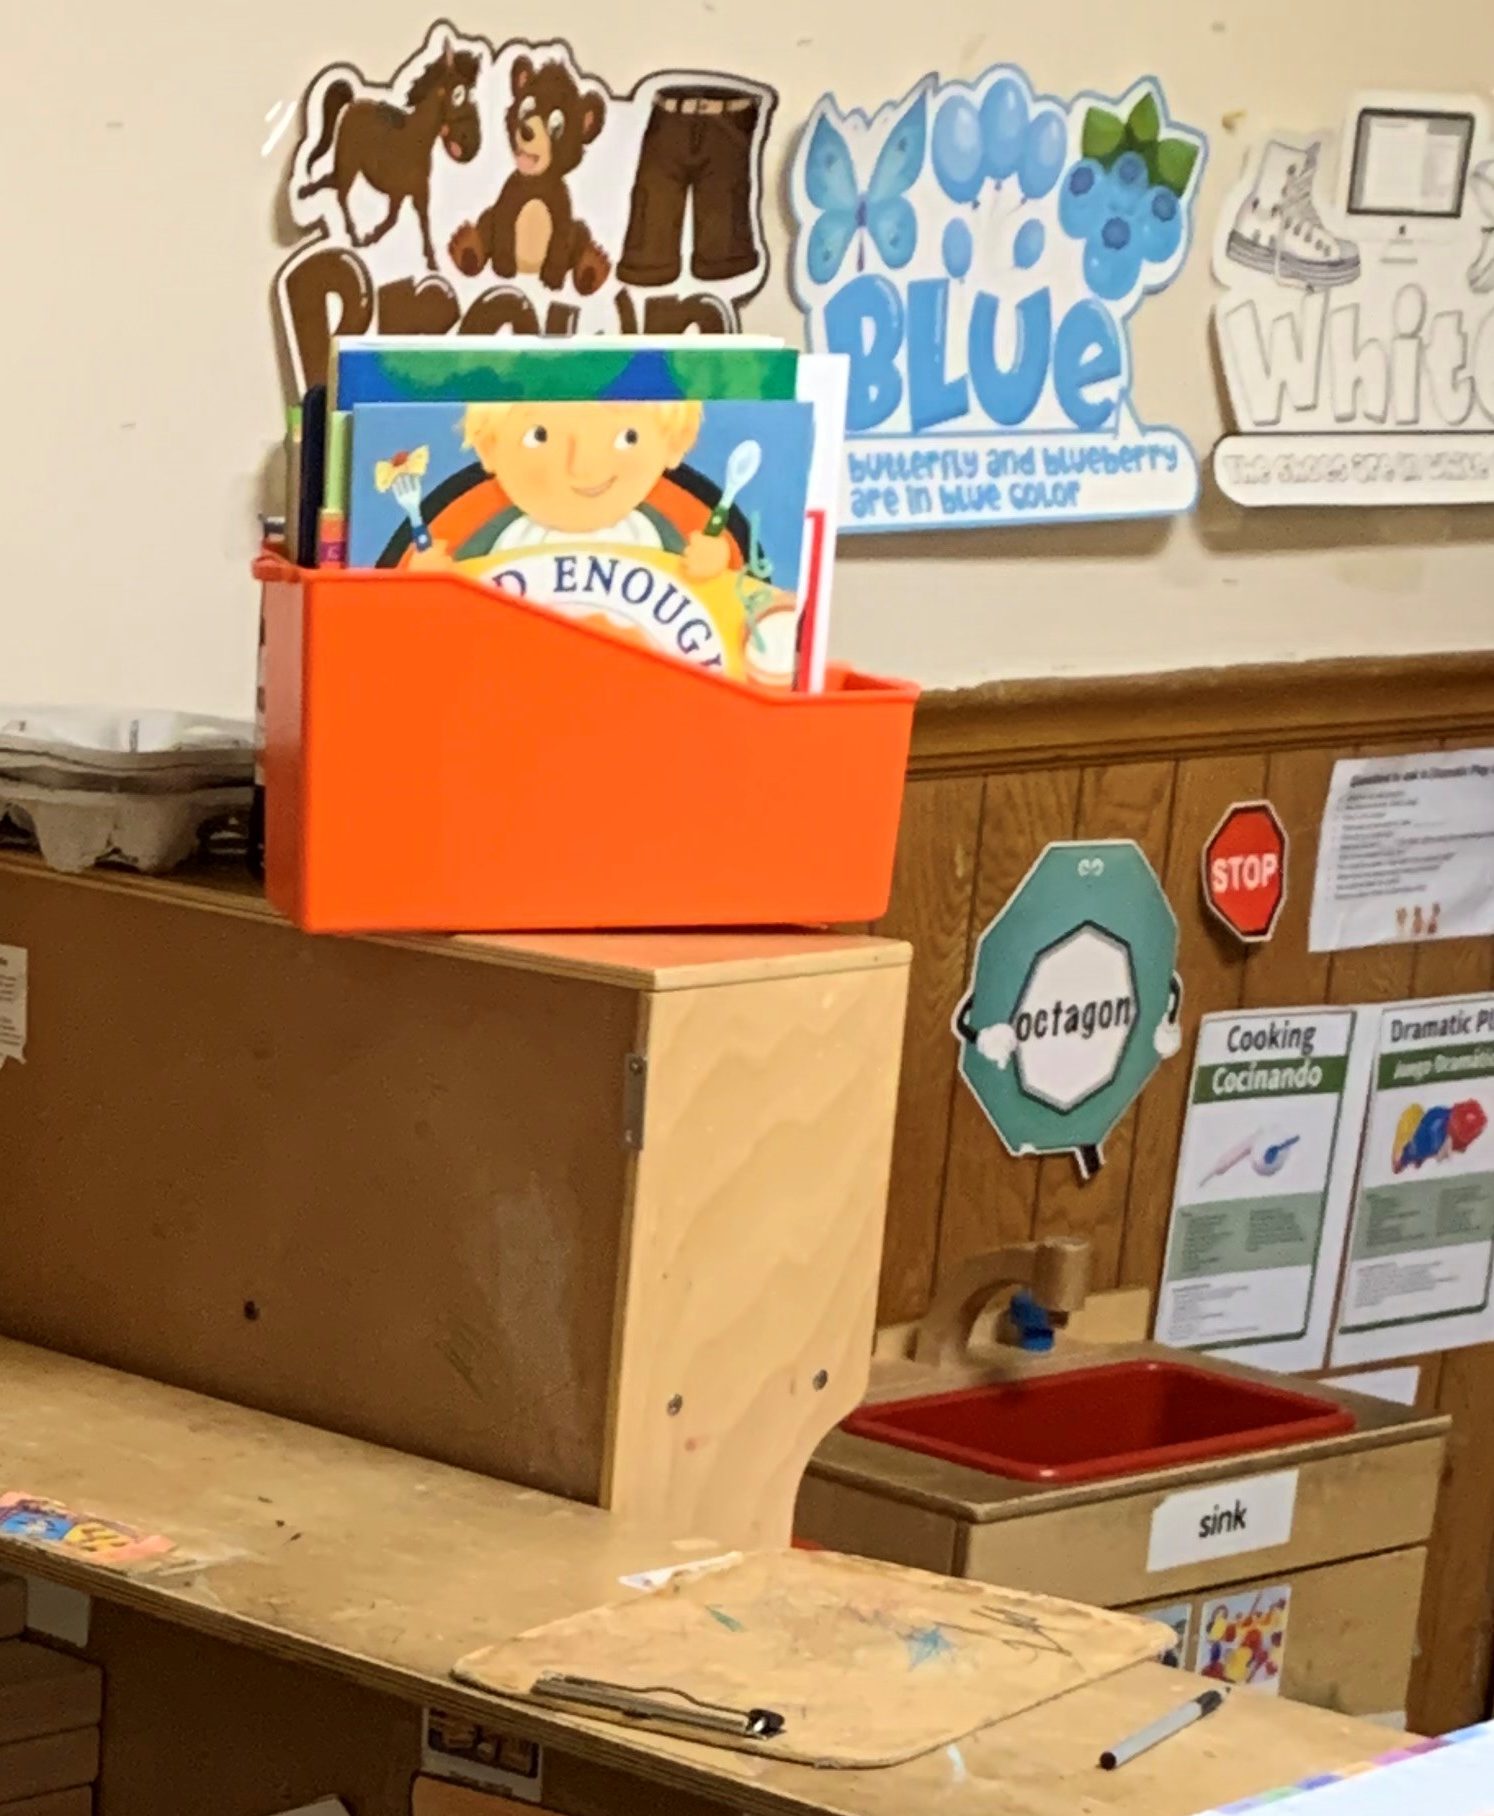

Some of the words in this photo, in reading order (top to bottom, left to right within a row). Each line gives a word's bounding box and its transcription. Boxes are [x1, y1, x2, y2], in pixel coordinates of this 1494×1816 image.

[848, 447, 978, 482] butterfly
[986, 446, 1035, 477] and
[1043, 443, 1179, 478] blueberry
[850, 487, 900, 518] are
[907, 484, 933, 514] in
[940, 481, 1002, 514] blue
[1008, 481, 1081, 511] color
[1212, 854, 1278, 893] STOP
[1016, 997, 1131, 1041] octagon
[1227, 1017, 1317, 1054] Cooking
[1391, 1010, 1472, 1043] Dramatic
[1212, 1061, 1323, 1095] Cocinando
[1198, 1499, 1248, 1538] sink
